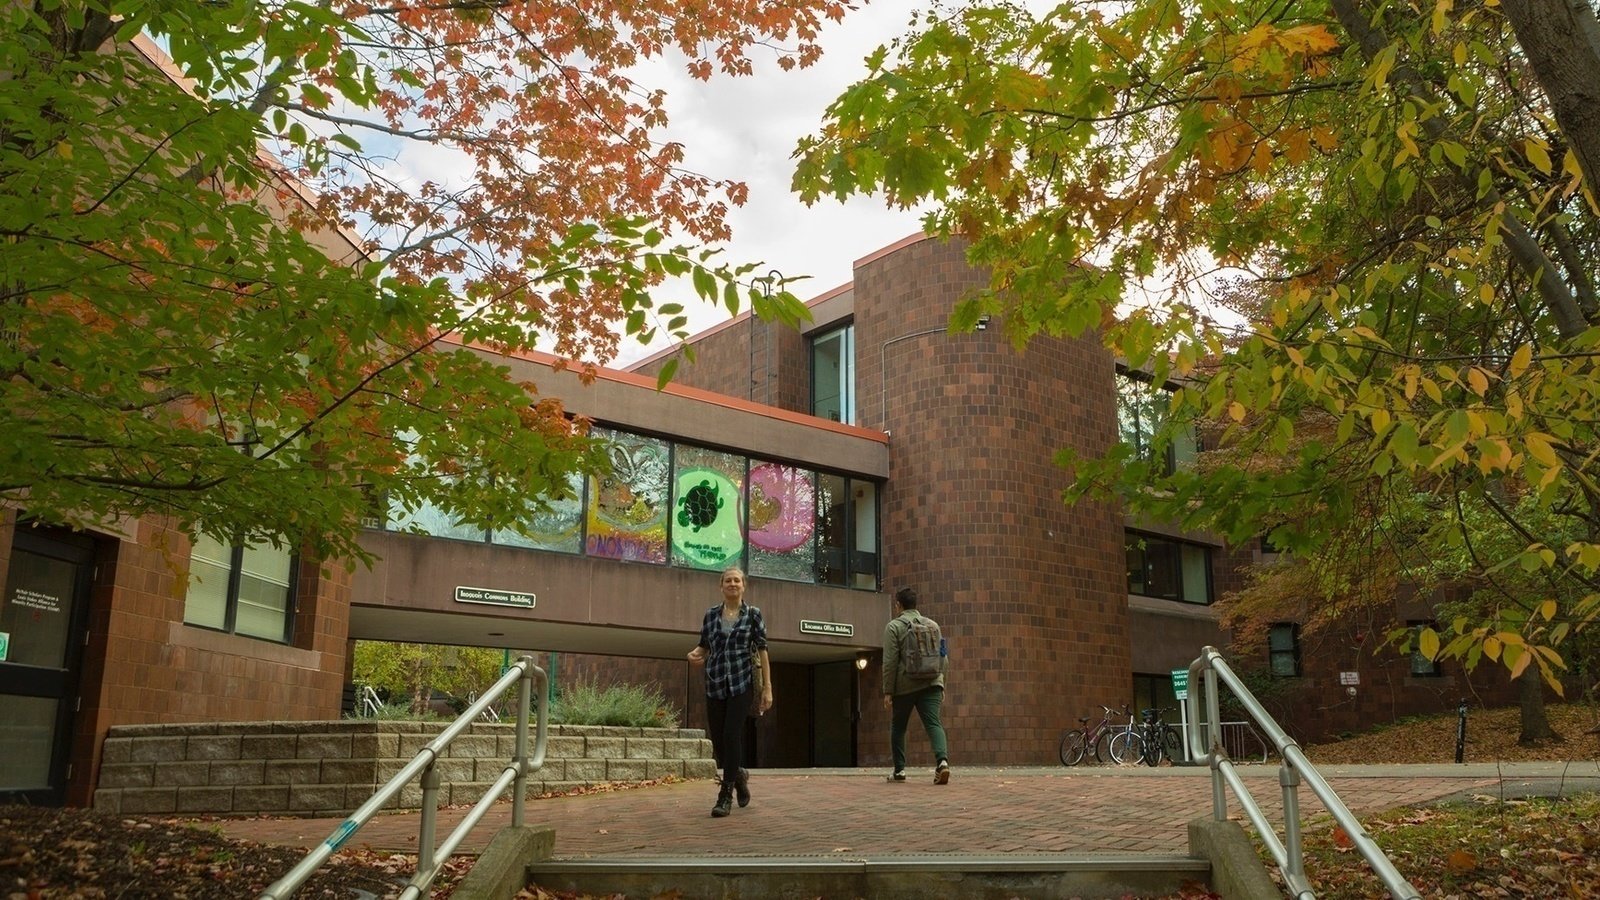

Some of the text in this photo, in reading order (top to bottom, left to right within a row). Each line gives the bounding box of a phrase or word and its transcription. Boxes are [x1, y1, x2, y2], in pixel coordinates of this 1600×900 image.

[460, 590, 531, 605] Iroquois Commons Building
[823, 624, 835, 632] Office
[835, 625, 851, 634] Building
